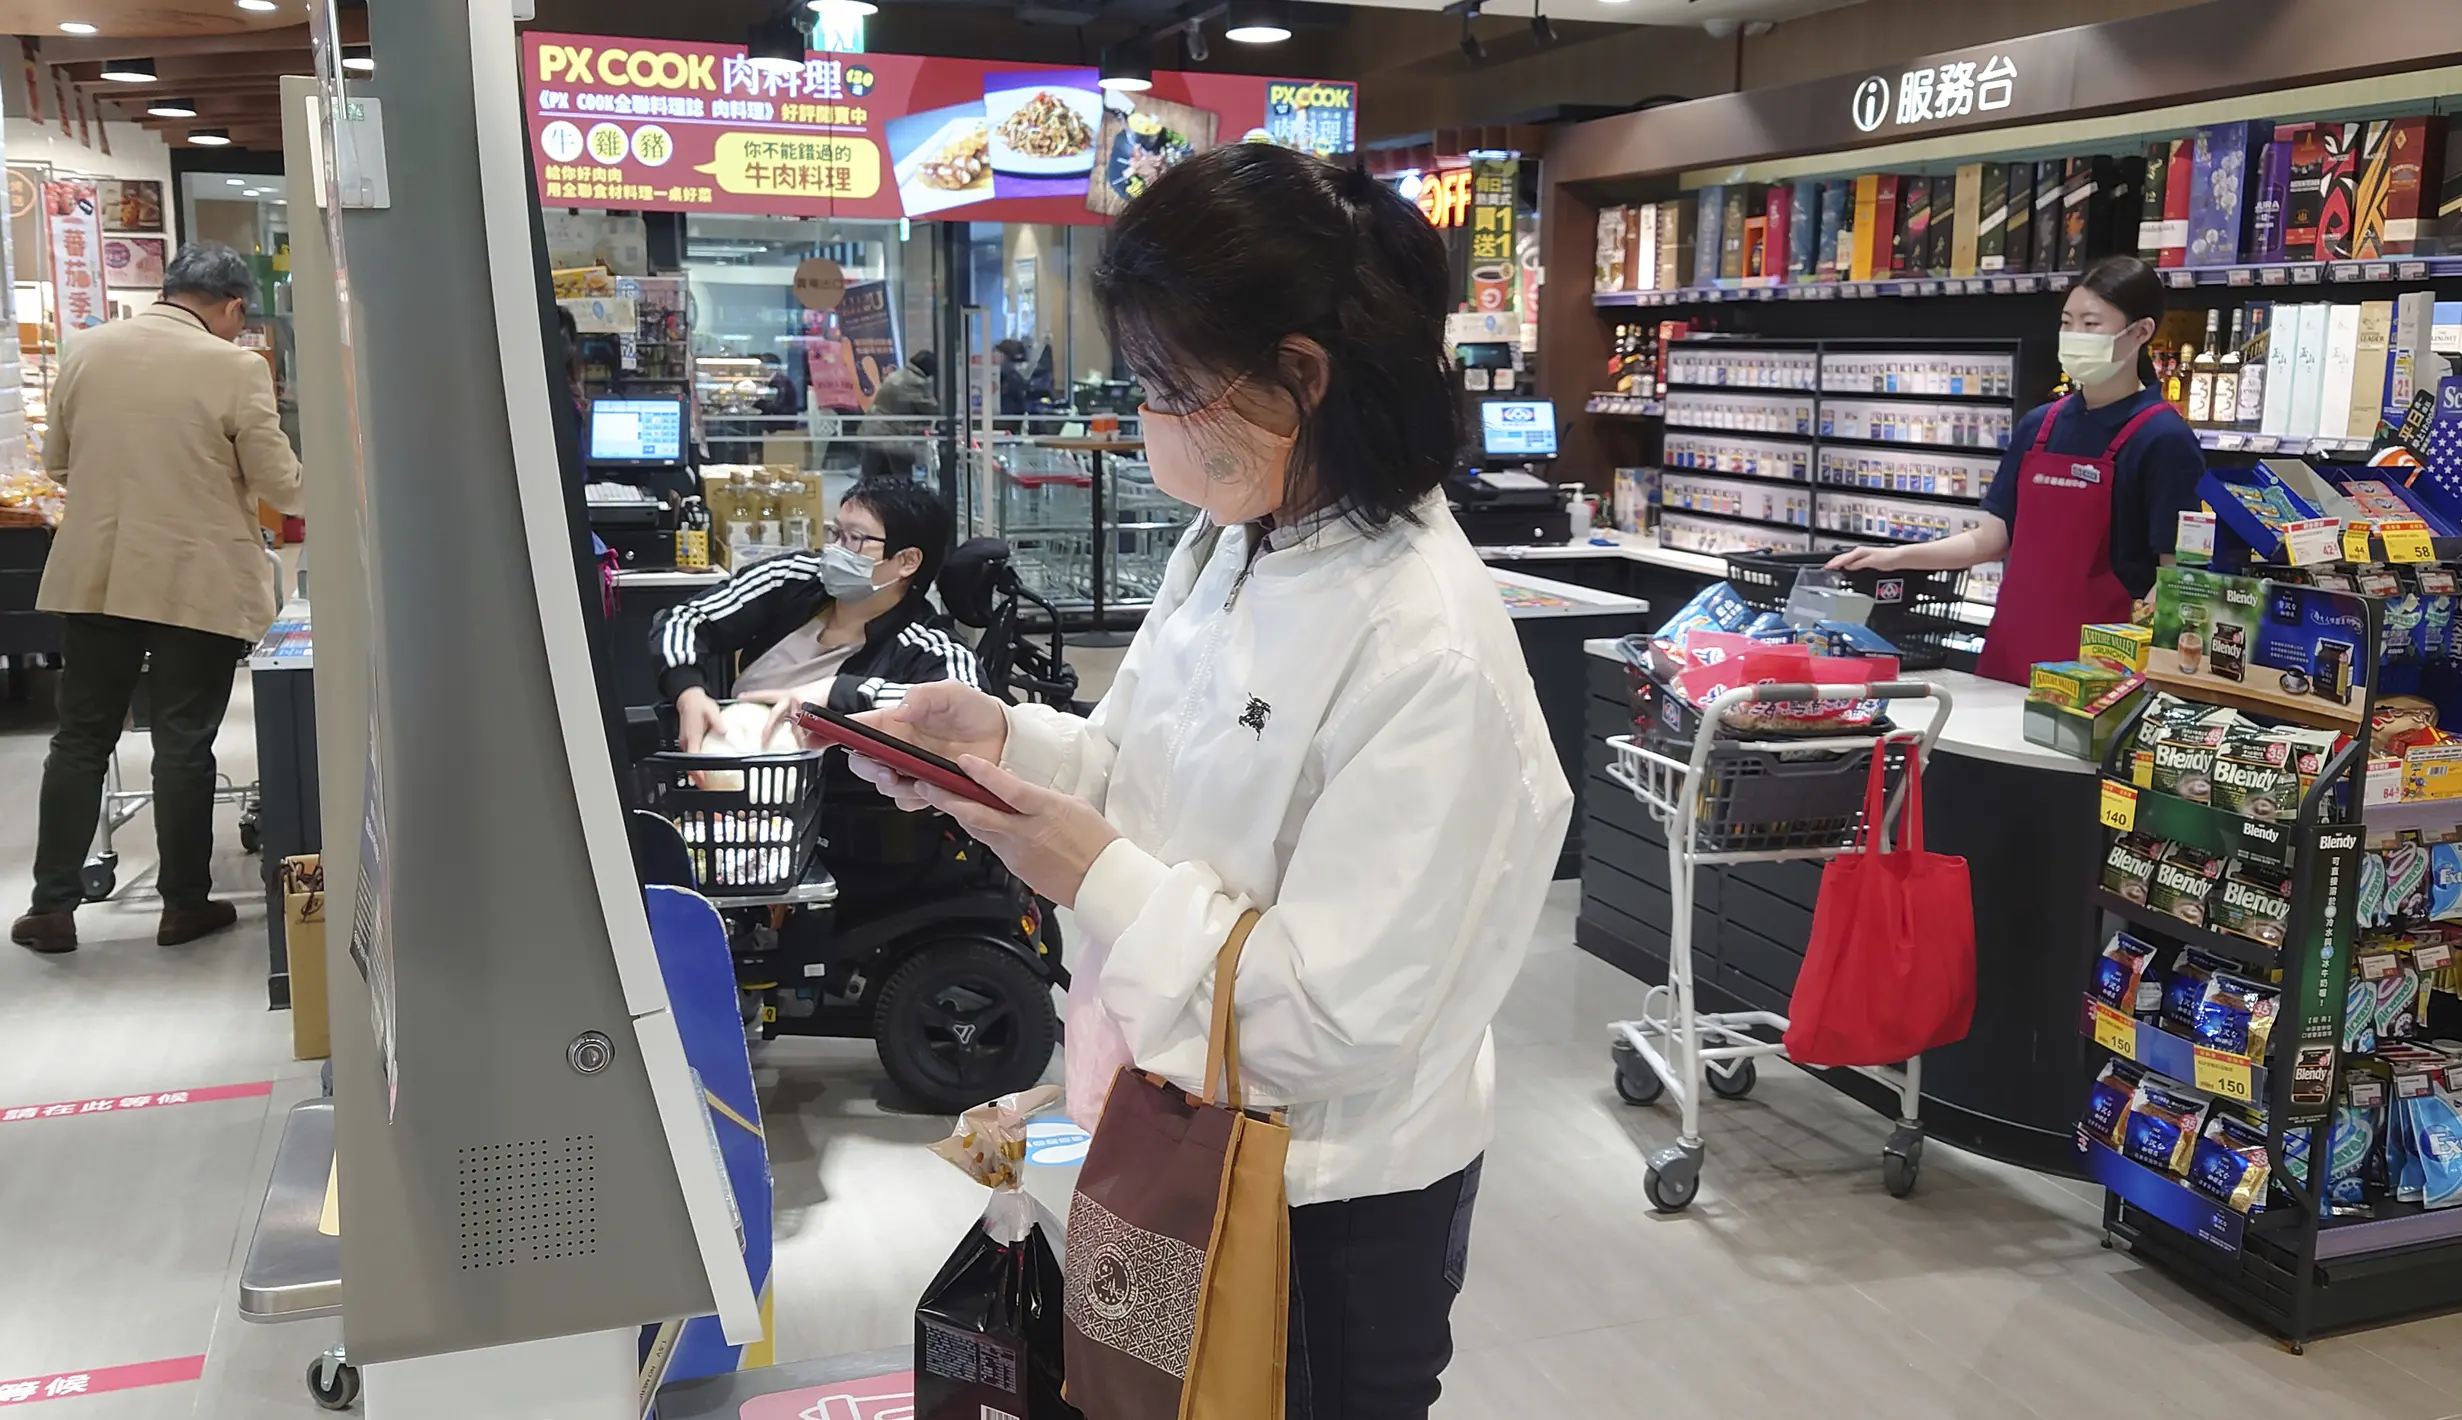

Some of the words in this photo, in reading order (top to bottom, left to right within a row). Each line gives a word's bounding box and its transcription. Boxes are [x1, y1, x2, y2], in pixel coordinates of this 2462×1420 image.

[539, 45, 594, 83] PX
[597, 48, 717, 91] COOK
[1270, 85, 1296, 104] PX
[1295, 86, 1349, 108] COOK
[1896, 55, 2018, 125] 服務台
[595, 130, 621, 157] 雞
[640, 133, 665, 159] 豬
[744, 140, 852, 162] 你不能錯過的
[744, 161, 852, 192] 牛肉料理
[2399, 409, 2425, 443] 平日
[2414, 546, 2430, 558] 58
[2226, 589, 2258, 607] Blendy
[2084, 629, 2112, 645] NATURE
[2112, 637, 2136, 658] VALLEY
[2212, 638, 2242, 659] Blendy
[2155, 744, 2213, 774] Blendy
[2267, 749, 2285, 760] 35
[2213, 760, 2278, 792] Blendy
[2106, 809, 2127, 826] 140
[2243, 822, 2280, 843] Blendy
[2319, 835, 2357, 849] Blendy
[2107, 846, 2154, 881] Blendy
[2157, 863, 2213, 900] Blendy
[2223, 881, 2291, 920] Blendy
[2111, 1035, 2131, 1054] 150
[2295, 1067, 2328, 1081] Blendy
[2218, 1078, 2245, 1095] 150
[2, 1091, 189, 1121] 請在此等候
[2183, 1118, 2196, 1130] 35
